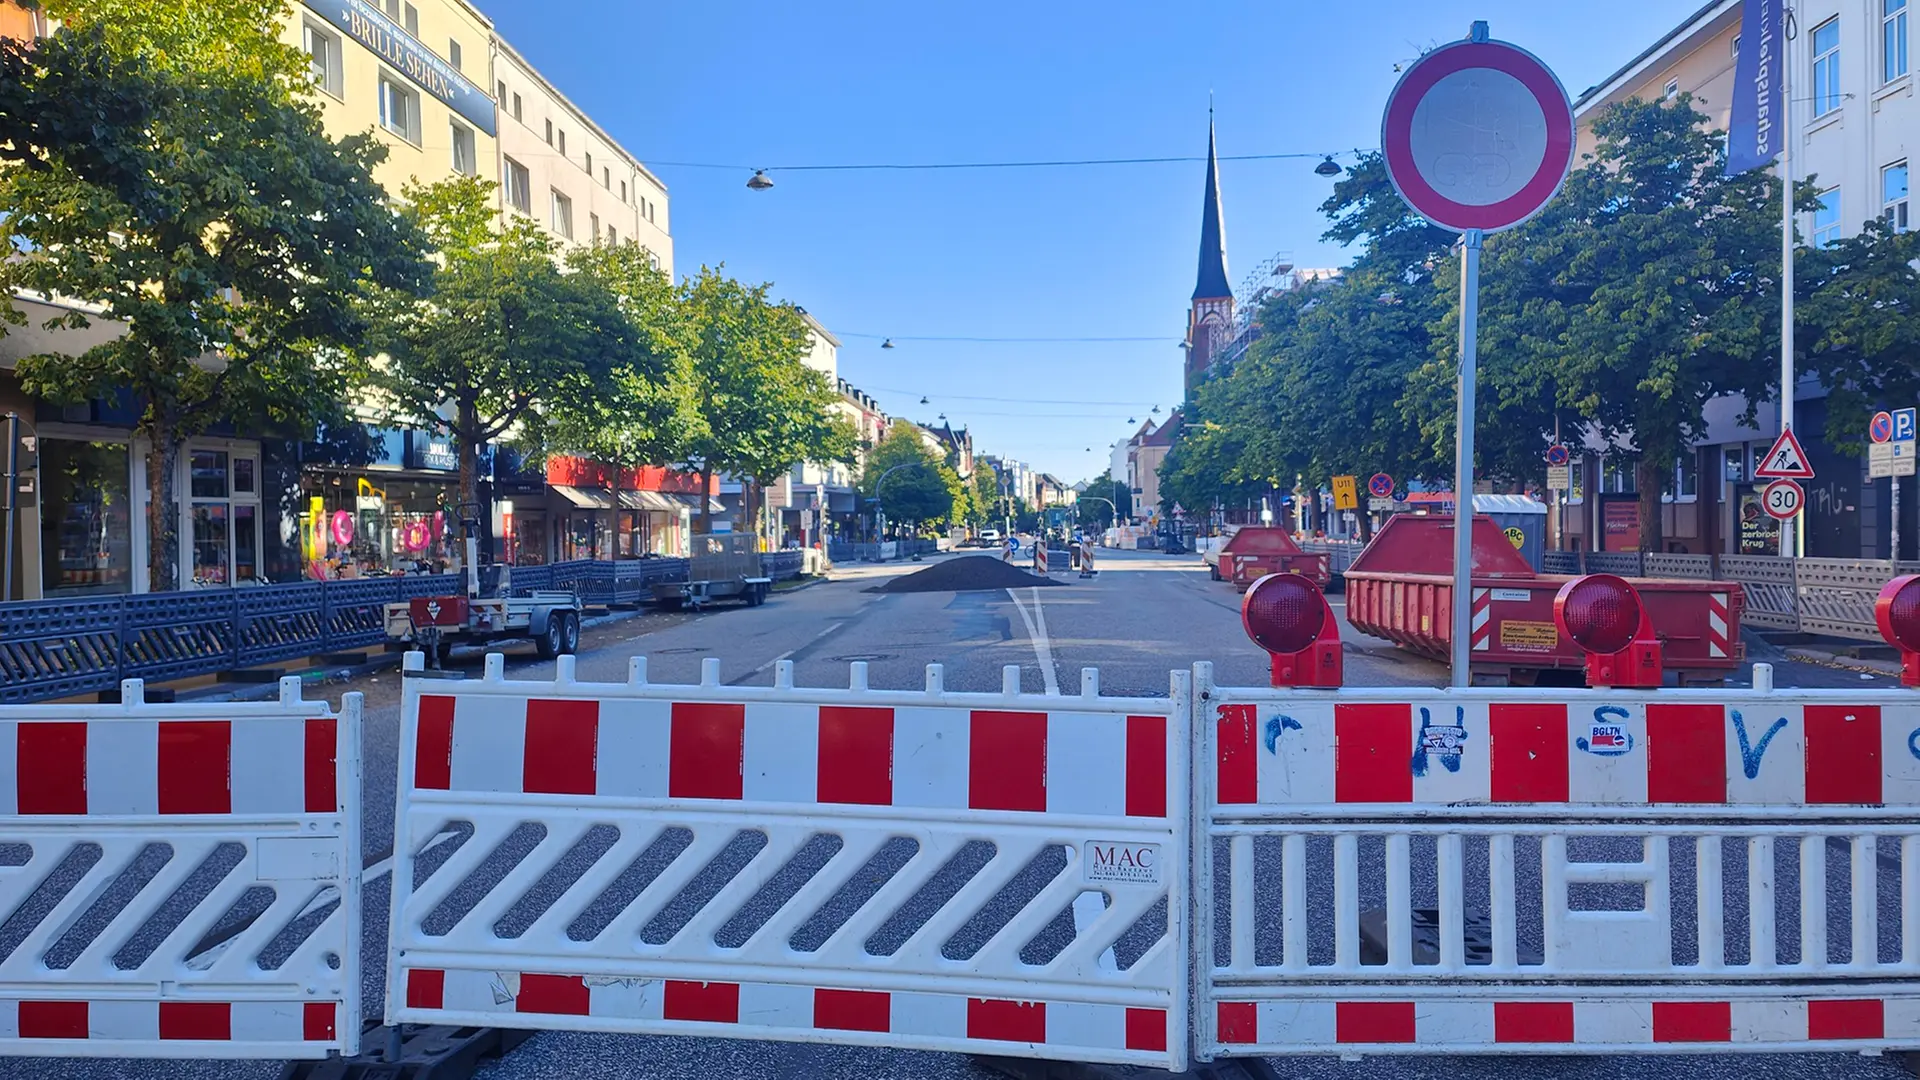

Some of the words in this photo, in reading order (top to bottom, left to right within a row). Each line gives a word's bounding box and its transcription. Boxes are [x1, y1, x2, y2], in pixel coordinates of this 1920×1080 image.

[1897, 413, 1910, 438] P
[1337, 480, 1351, 488] U11
[1771, 490, 1795, 508] 30
[1742, 539, 1765, 548] Krug
[1593, 727, 1621, 736] BGLTN
[1731, 709, 1788, 779] V
[1094, 846, 1153, 868] MAC
